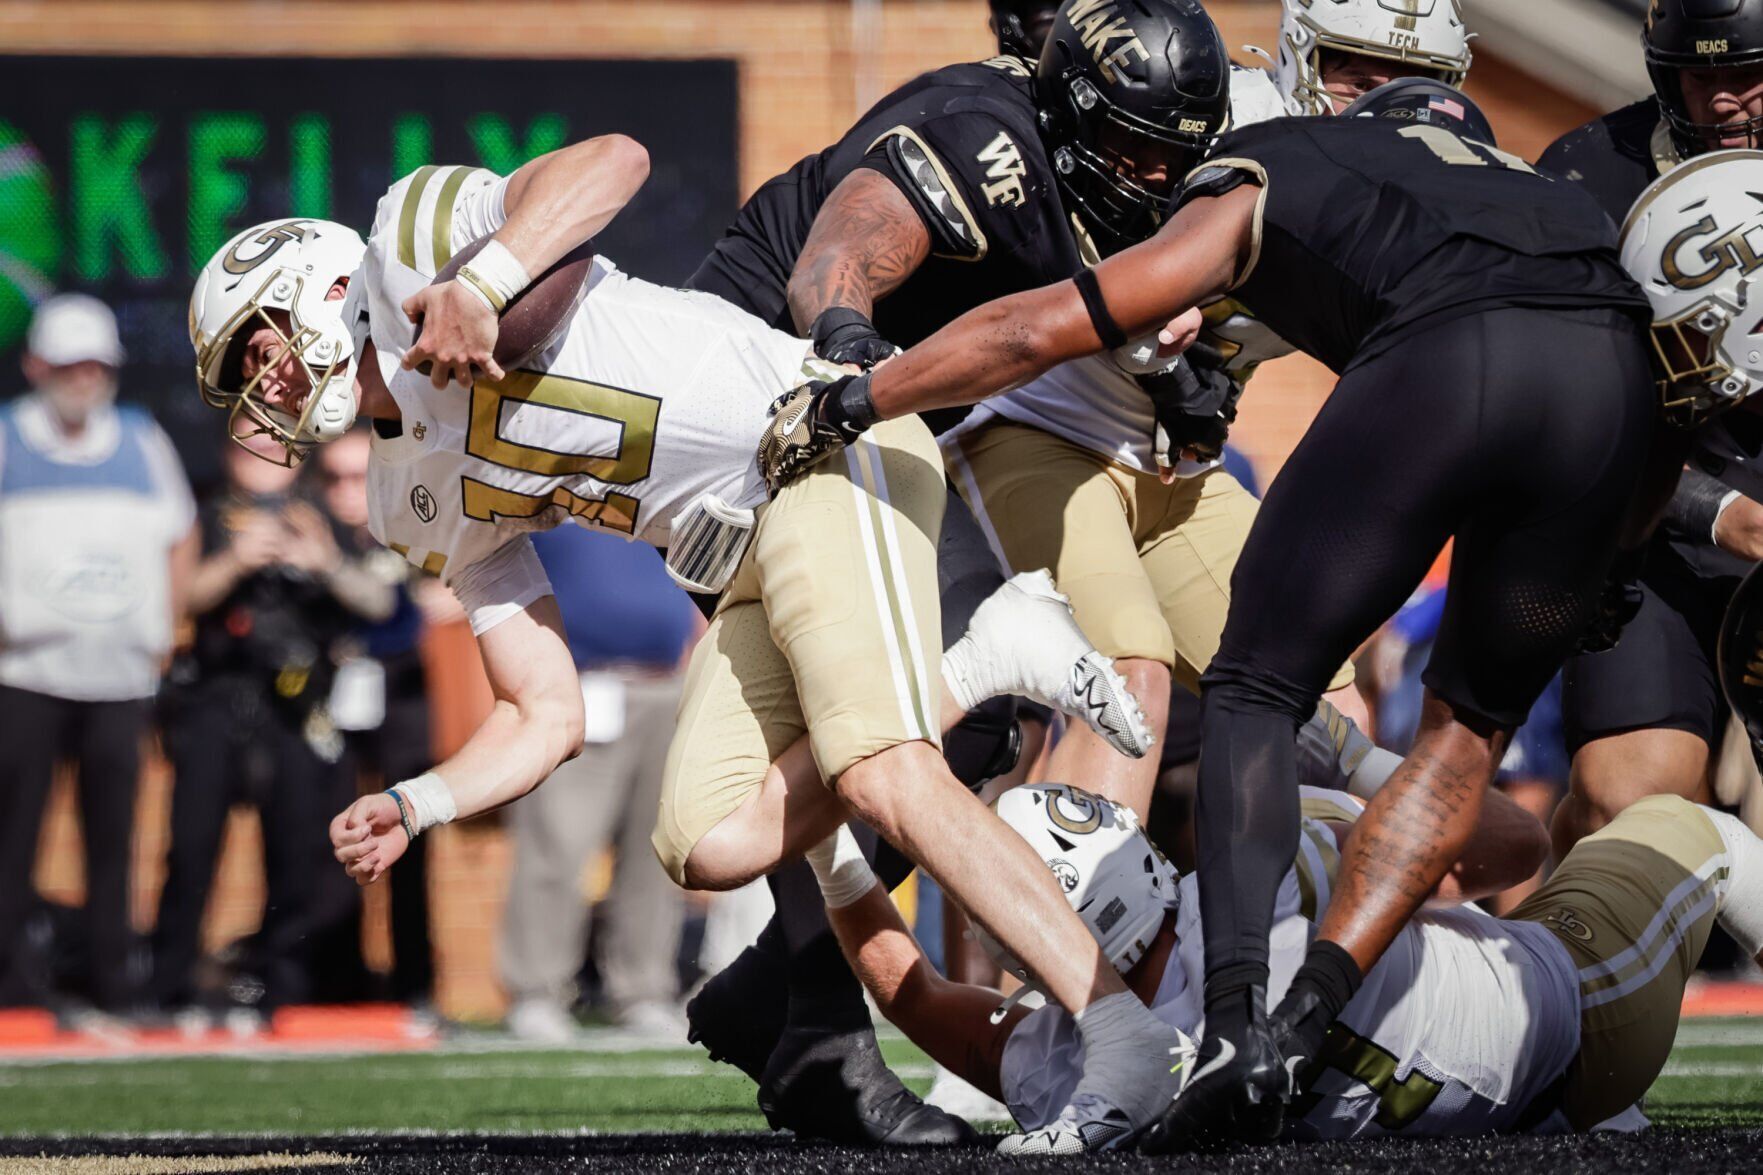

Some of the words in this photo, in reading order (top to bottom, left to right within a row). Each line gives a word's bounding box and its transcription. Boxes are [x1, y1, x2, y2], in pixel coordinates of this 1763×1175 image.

[1066, 0, 1151, 85] WAKE
[1388, 31, 1420, 49] TECH
[1695, 39, 1728, 54] DEACS
[1178, 118, 1207, 133] DEACS
[976, 131, 1026, 207] WF
[461, 368, 663, 536] 10
